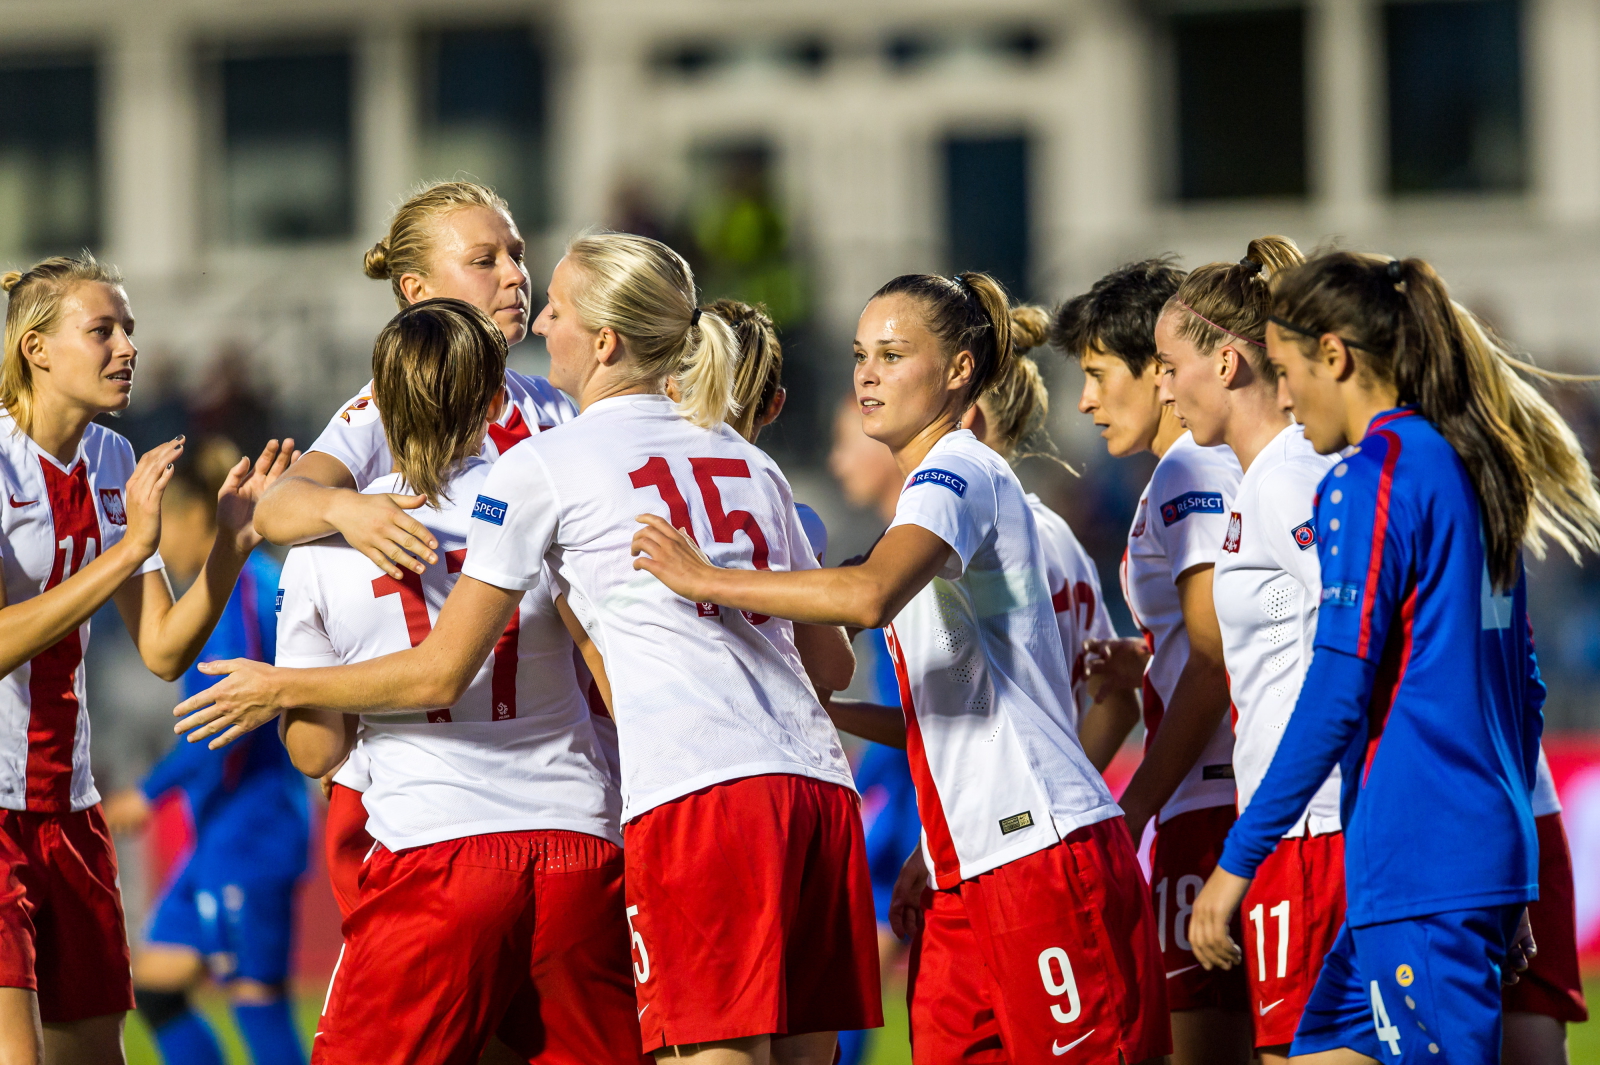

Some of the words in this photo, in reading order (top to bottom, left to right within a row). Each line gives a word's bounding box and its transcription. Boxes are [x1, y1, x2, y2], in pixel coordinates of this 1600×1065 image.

[474, 501, 506, 519] SPECT
[916, 471, 966, 491] RESPECT
[1176, 497, 1222, 514] RESPECT
[625, 904, 650, 984] 5
[1156, 873, 1204, 953] 18
[1249, 900, 1290, 982] 11
[1037, 946, 1081, 1024] 9
[1370, 980, 1402, 1056] 4
